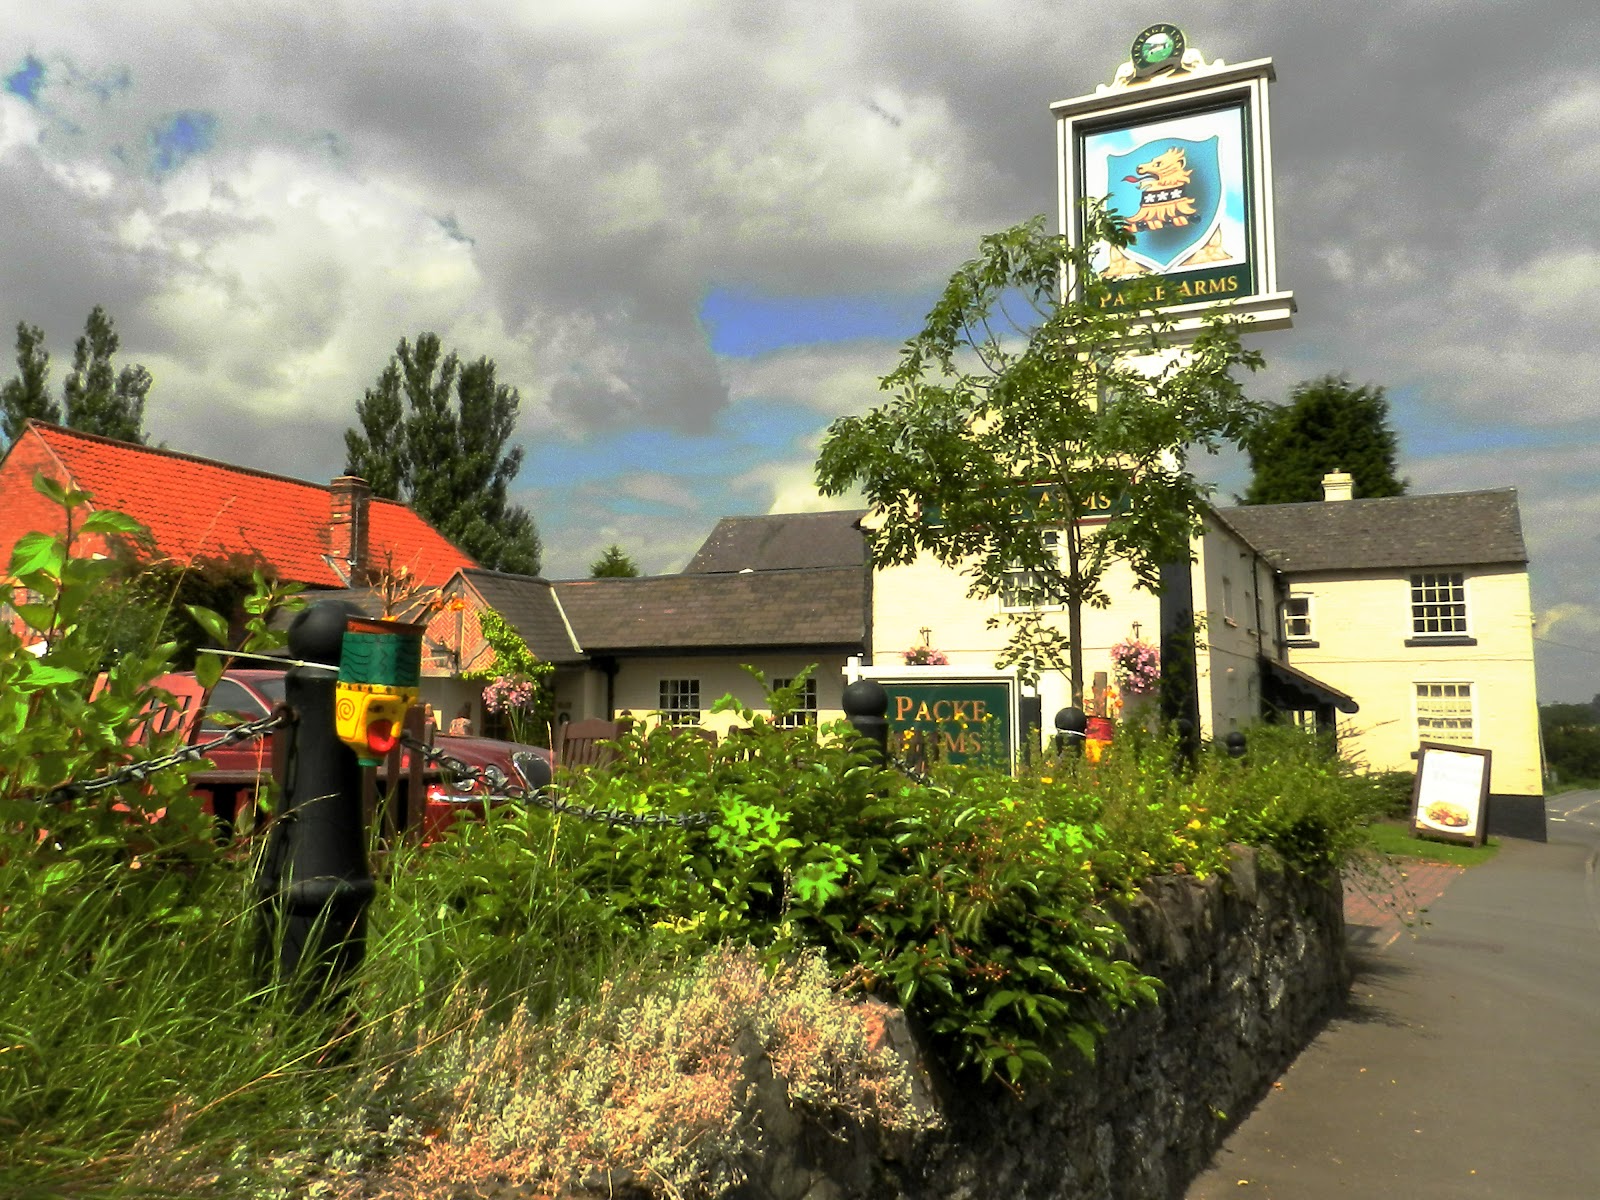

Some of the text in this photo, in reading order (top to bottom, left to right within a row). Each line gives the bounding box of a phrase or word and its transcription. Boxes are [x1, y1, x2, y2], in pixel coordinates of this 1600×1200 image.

[1099, 275, 1238, 308] PAE ARMS
[894, 695, 987, 722] PACKE
